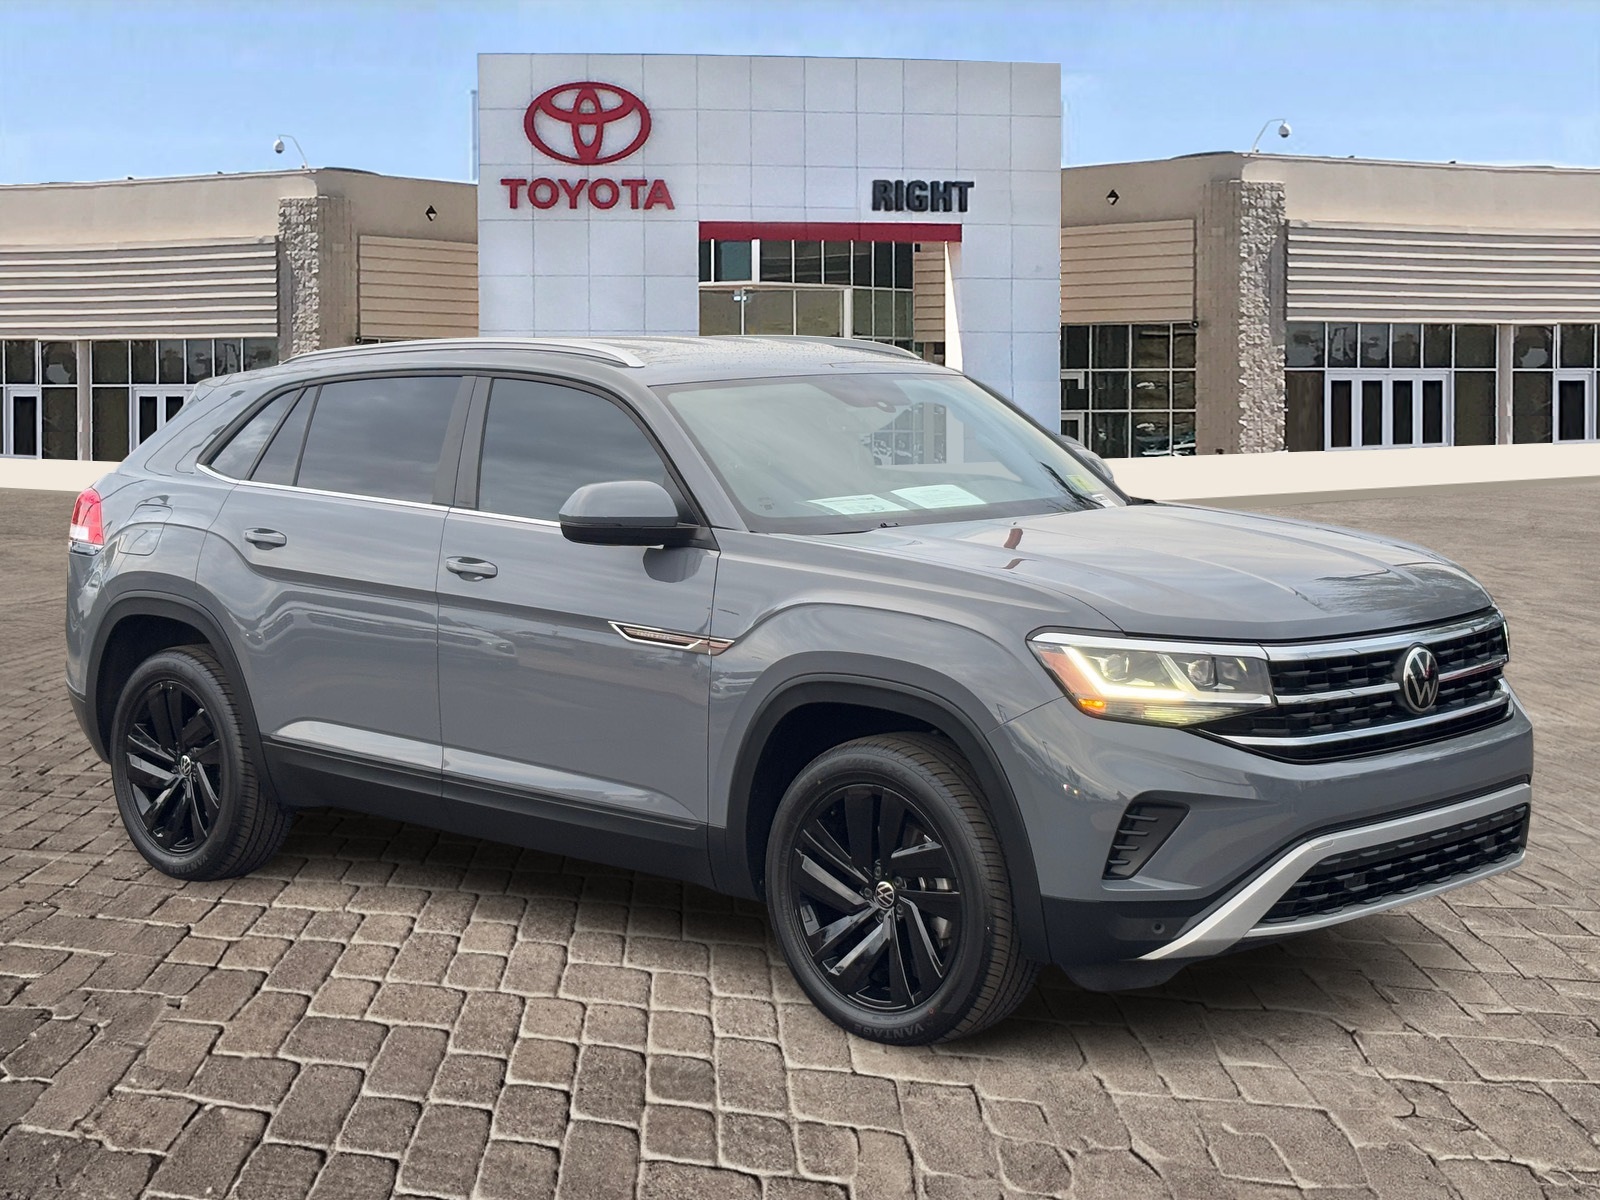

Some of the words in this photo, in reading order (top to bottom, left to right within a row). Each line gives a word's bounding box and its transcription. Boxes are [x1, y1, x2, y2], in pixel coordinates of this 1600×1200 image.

[500, 178, 675, 210] TOYOTA
[872, 179, 975, 213] RIGHT
[853, 1022, 925, 1040] VANTAGE
